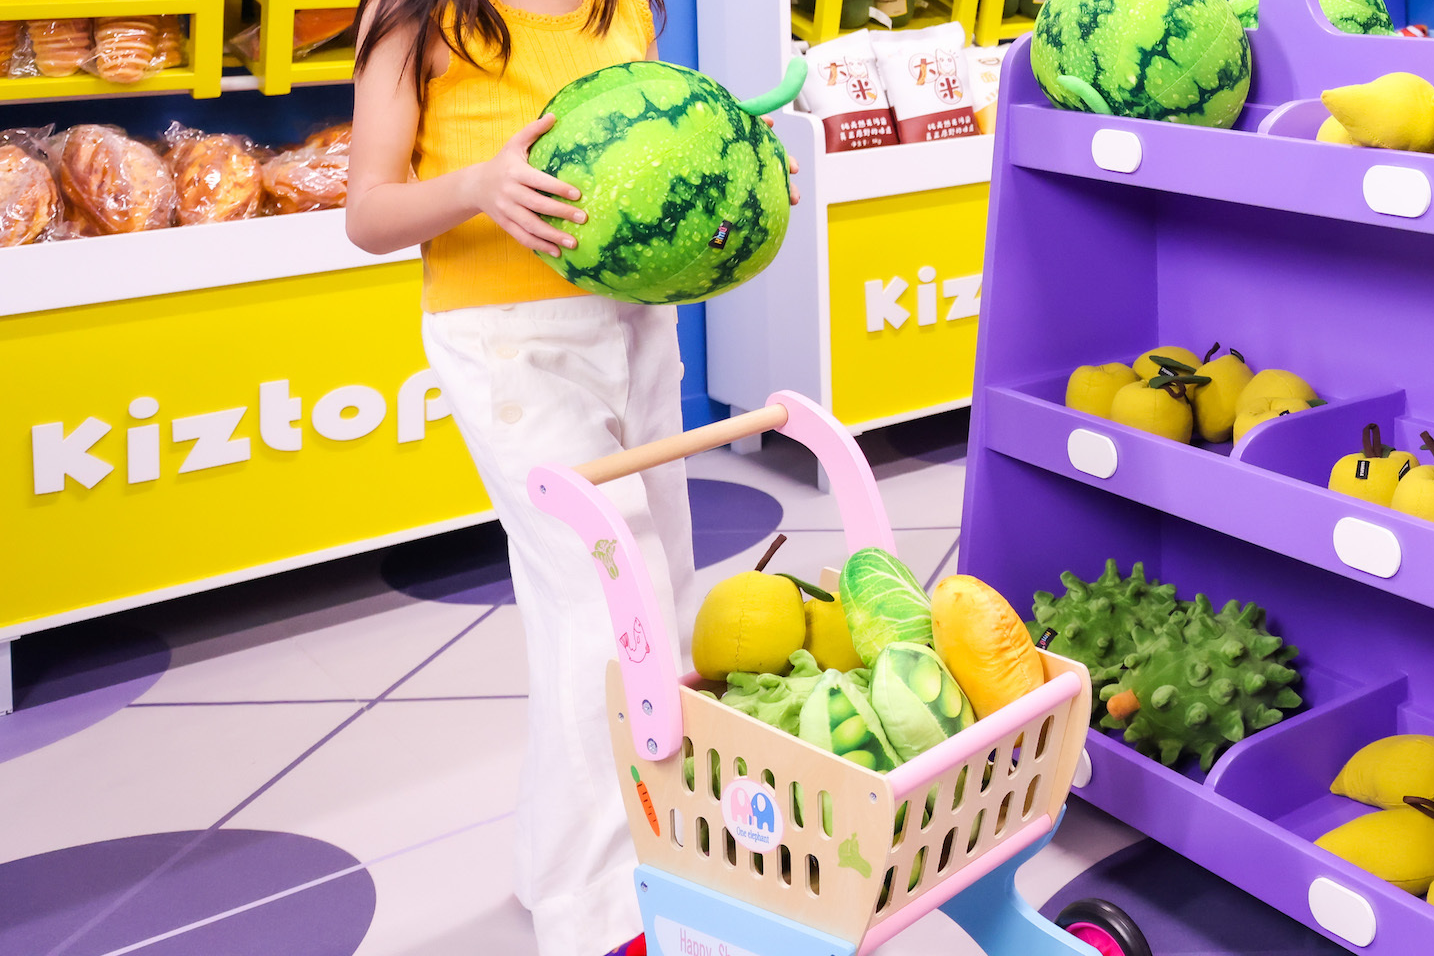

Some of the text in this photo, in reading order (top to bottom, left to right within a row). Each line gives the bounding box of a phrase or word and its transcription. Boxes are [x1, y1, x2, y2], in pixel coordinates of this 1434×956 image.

[864, 265, 983, 333] Kiz
[31, 368, 453, 495] Kiztop
[736, 826, 770, 843] One elephant
